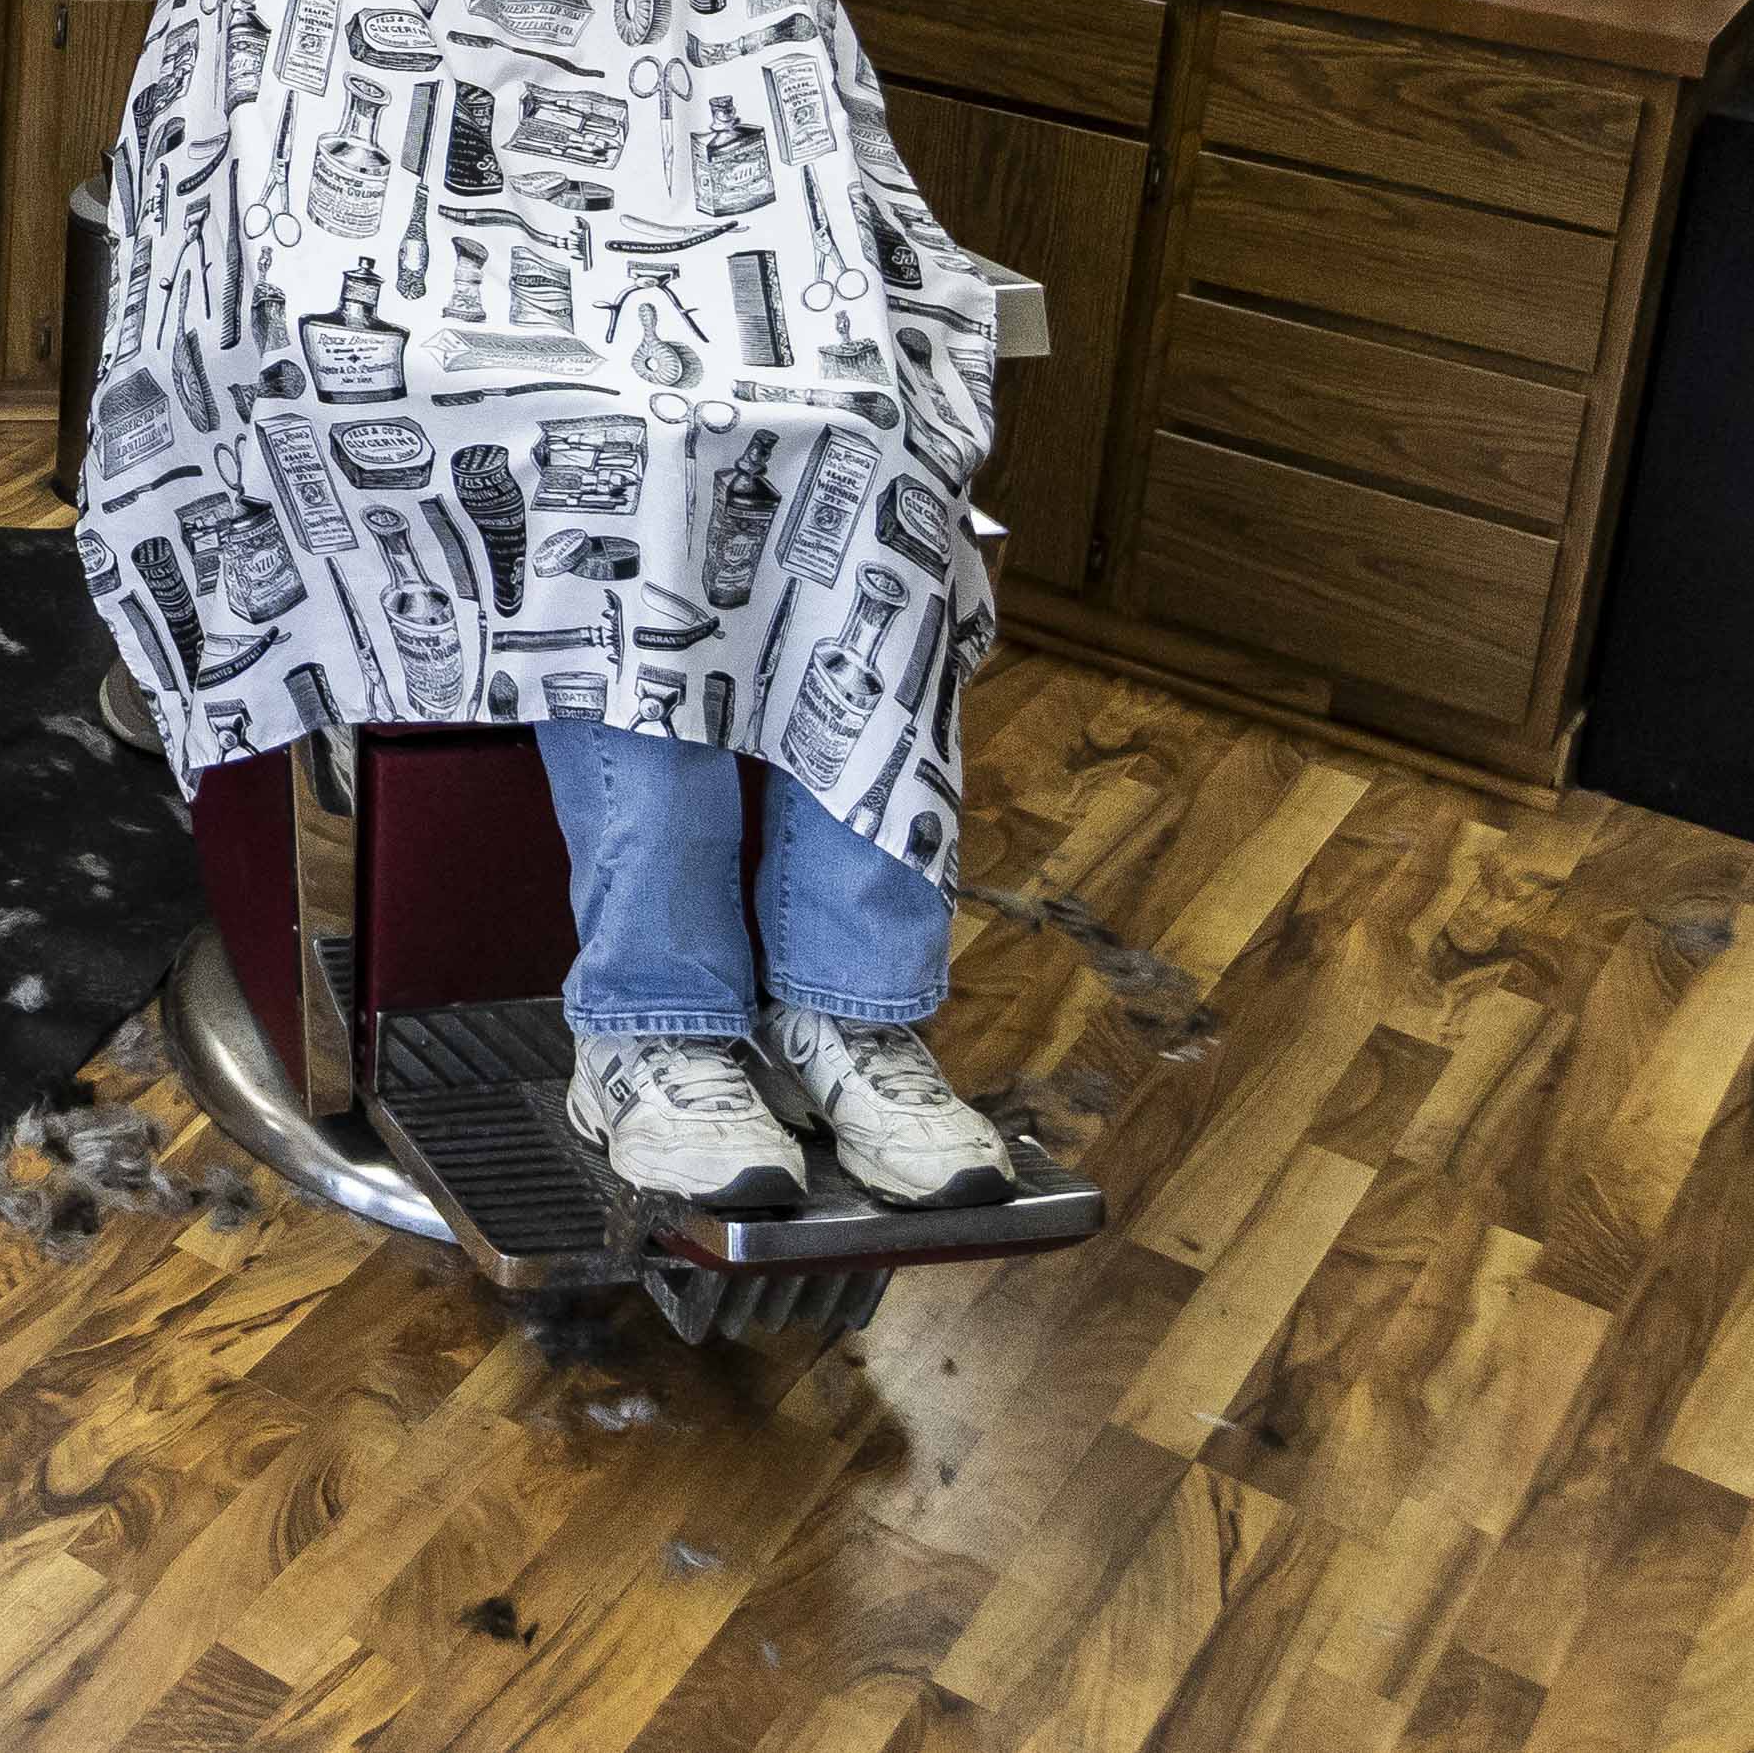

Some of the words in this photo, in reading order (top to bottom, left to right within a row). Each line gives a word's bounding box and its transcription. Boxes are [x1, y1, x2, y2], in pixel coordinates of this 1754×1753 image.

[347, 427, 369, 439] FELS
[345, 435, 418, 450] GLYCERINE
[283, 451, 315, 464] HAIR
[457, 475, 485, 490] FELS
[825, 469, 860, 490] HAIR
